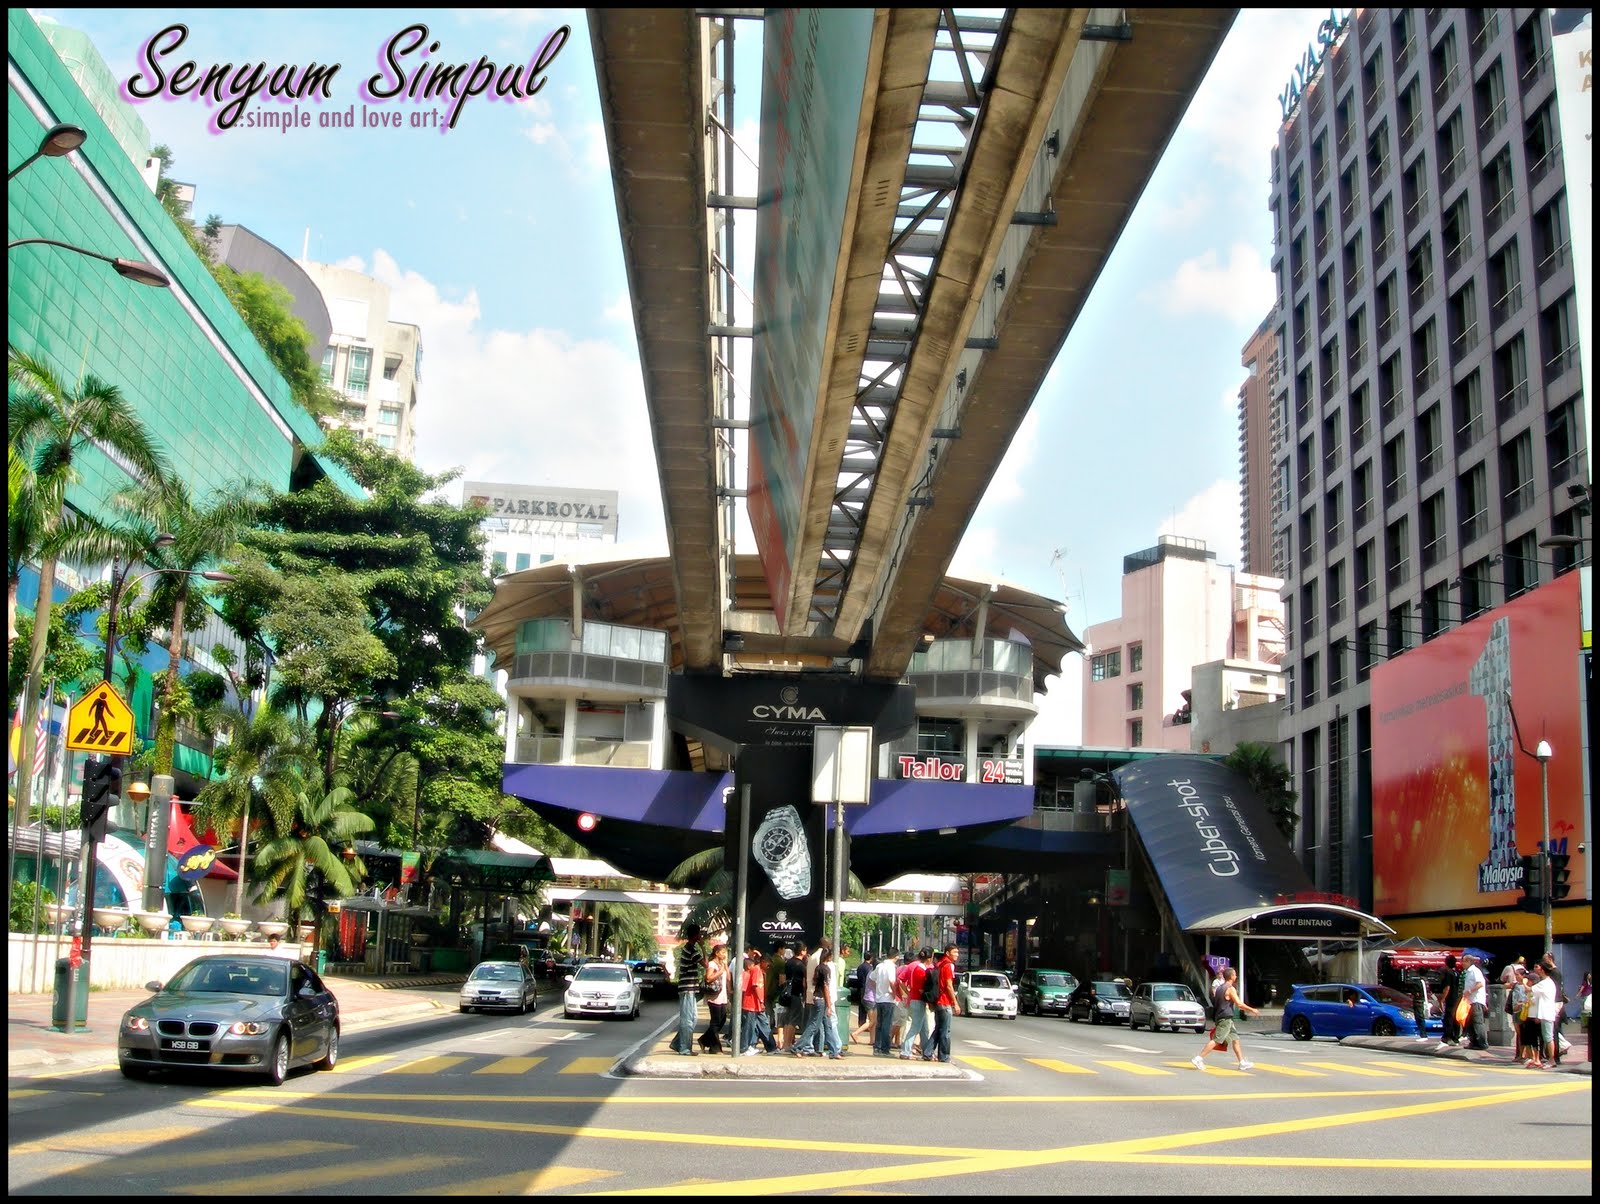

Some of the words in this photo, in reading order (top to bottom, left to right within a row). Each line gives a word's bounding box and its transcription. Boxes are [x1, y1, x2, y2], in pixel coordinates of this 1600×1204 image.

[493, 498, 609, 520] PARKROYAL
[752, 705, 826, 720] CYMA
[899, 756, 964, 780] Tailor
[982, 760, 1005, 783] 24
[1483, 863, 1524, 888] Malaysia
[761, 921, 803, 930] CYMA
[1272, 918, 1296, 926] BUKIT
[1298, 918, 1332, 927] BINTANG
[1454, 919, 1507, 933] Maybank
